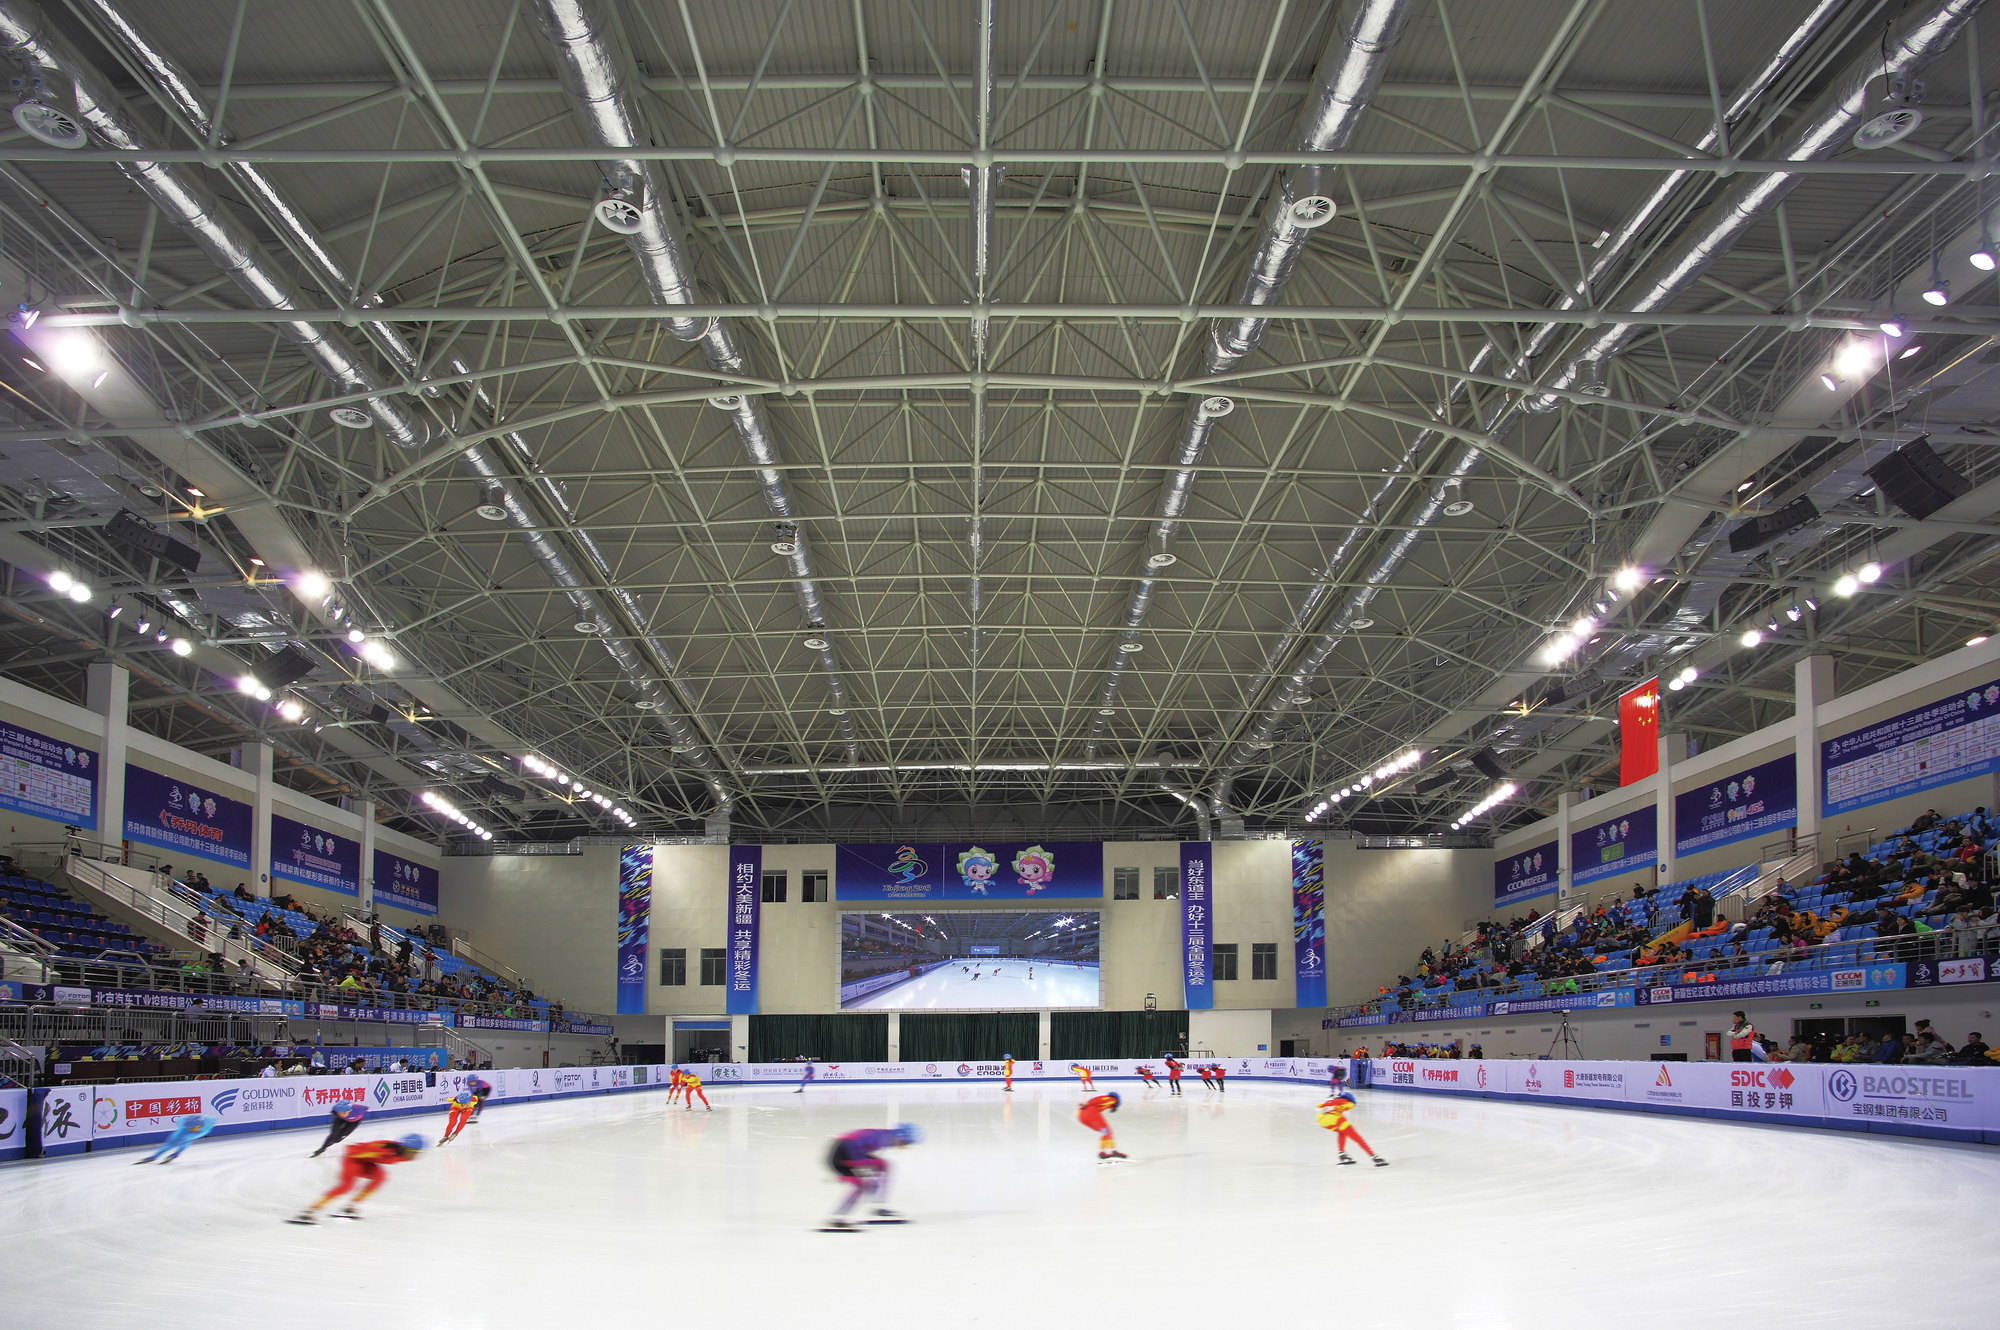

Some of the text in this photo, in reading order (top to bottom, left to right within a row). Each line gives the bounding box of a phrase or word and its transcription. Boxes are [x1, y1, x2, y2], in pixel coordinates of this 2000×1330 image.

[171, 816, 223, 842] 乔丹体育
[734, 863, 753, 991] 相约大美新疆 共享精彩冬运
[1188, 860, 1205, 986] 当好东道主 办好十三届全国冬运会
[1835, 972, 1862, 980] CCCM
[96, 992, 258, 1012] 北京汽车工业控股有限公与您共享精彩冬运
[1393, 1062, 1414, 1072] CCCM
[1393, 1073, 1414, 1084] 正通传媒
[1428, 1070, 1458, 1082] 乔丹体育
[1576, 1074, 1623, 1082] 大唐新疆发电有限公司
[1731, 1070, 1765, 1088] SDIC
[242, 1088, 295, 1100] GOLDWIND
[393, 1079, 423, 1094] 中国国电
[1863, 1076, 1974, 1098] BAOSTEEL
[316, 1088, 365, 1104] 乔丹体育
[1731, 1091, 1793, 1110] 国投罗钾
[128, 1099, 199, 1117] 中国彩棉
[243, 1102, 274, 1112] 金风科技
[1852, 1103, 1947, 1122] 宝钢集团有限公司
